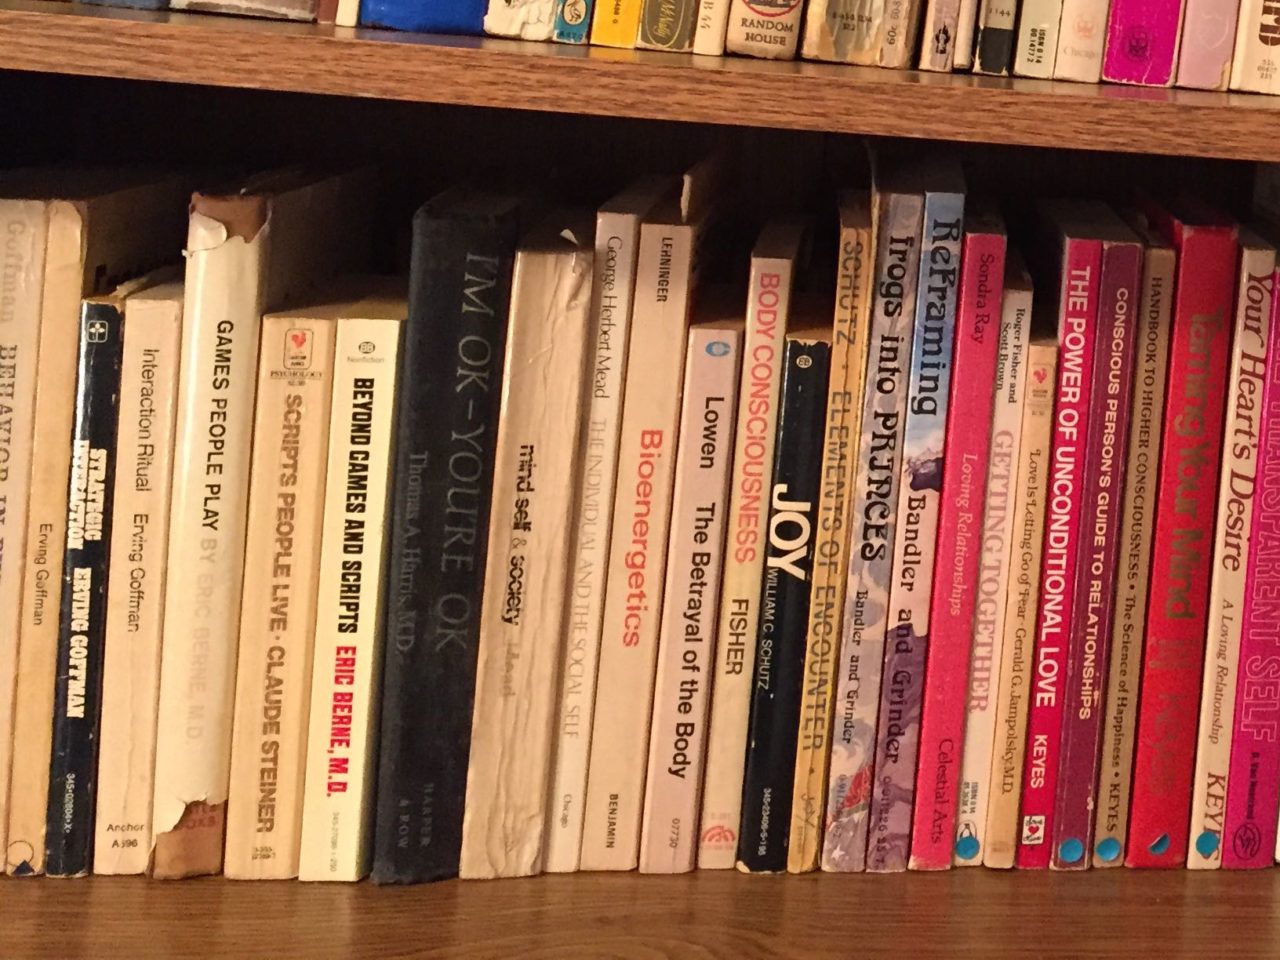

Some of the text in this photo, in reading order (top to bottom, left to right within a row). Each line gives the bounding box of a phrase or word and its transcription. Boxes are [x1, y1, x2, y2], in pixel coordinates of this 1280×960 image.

[741, 18, 794, 32] RANDOM
[744, 32, 787, 46] HOUSE
[656, 236, 673, 303] LEHNINGER
[594, 292, 619, 399] Herbert Mead
[1146, 276, 1163, 364] HANDBOOK
[134, 348, 160, 492] Interaction Ritual
[202, 320, 234, 530] GAMES PEOPLE PLAY
[279, 393, 303, 489] SCRIPTS
[735, 271, 781, 565] BODY CONSCIOUSNESS
[766, 483, 812, 580] JOY
[1035, 266, 1090, 708] THE POWER OF UNCONDITIONAL LOVE
[1079, 287, 1128, 721] CONSCIOUS GUIDE RELATIONSHIPS
[326, 377, 375, 754] BEYOND GAMES AND SCRIPTS ERIC BERNE,
[622, 428, 664, 649] Bioenergetics
[269, 583, 291, 632] LIVE
[668, 396, 726, 779] Lowen Betrayal Body
[885, 494, 926, 765] Bandler Grinder
[66, 634, 90, 719] GOFFMAN
[725, 598, 750, 676] FISHER
[756, 638, 773, 690] SCHUTZ
[260, 646, 287, 736] CLAUDE
[256, 740, 280, 833] STEINER
[1030, 734, 1048, 789] KEYES
[606, 794, 619, 849] BENJAMIN
